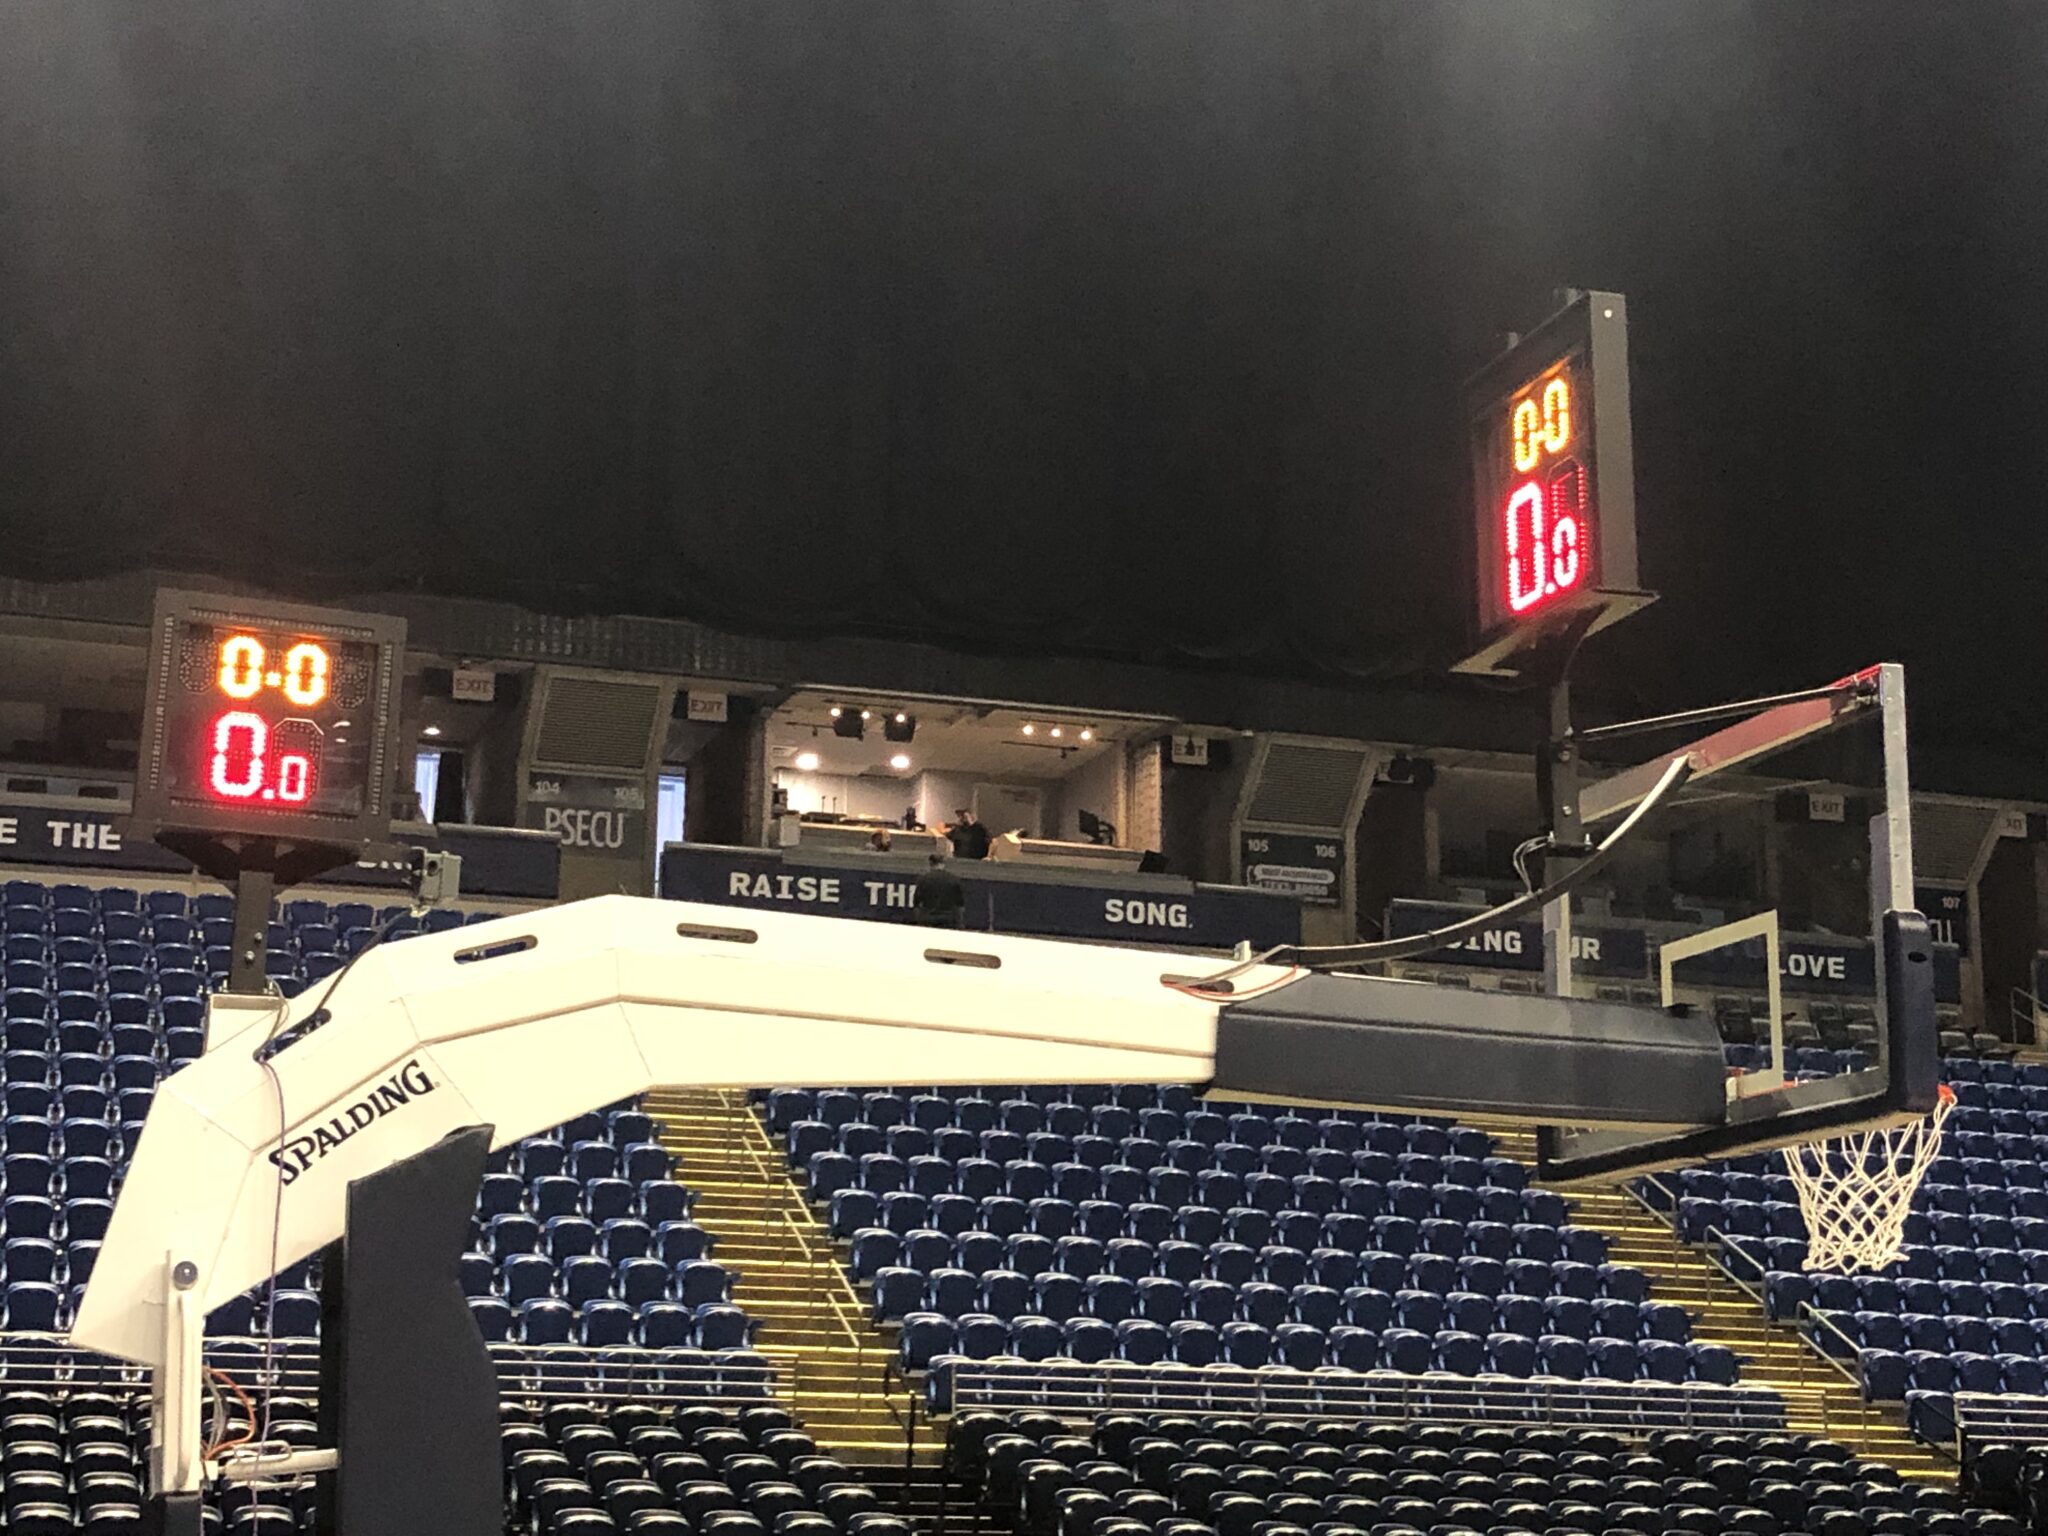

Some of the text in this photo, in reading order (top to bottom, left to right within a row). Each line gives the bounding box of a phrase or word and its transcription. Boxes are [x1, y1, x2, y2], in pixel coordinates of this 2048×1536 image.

[455, 678, 490, 693] EXIT
[691, 699, 722, 713] EXIT
[46, 820, 121, 851] THE
[545, 807, 624, 849] PSECU
[1248, 839, 1269, 852] 105
[729, 872, 840, 903] RAISE
[1446, 930, 1522, 954] ING
[268, 1059, 435, 1186] SPALDING
